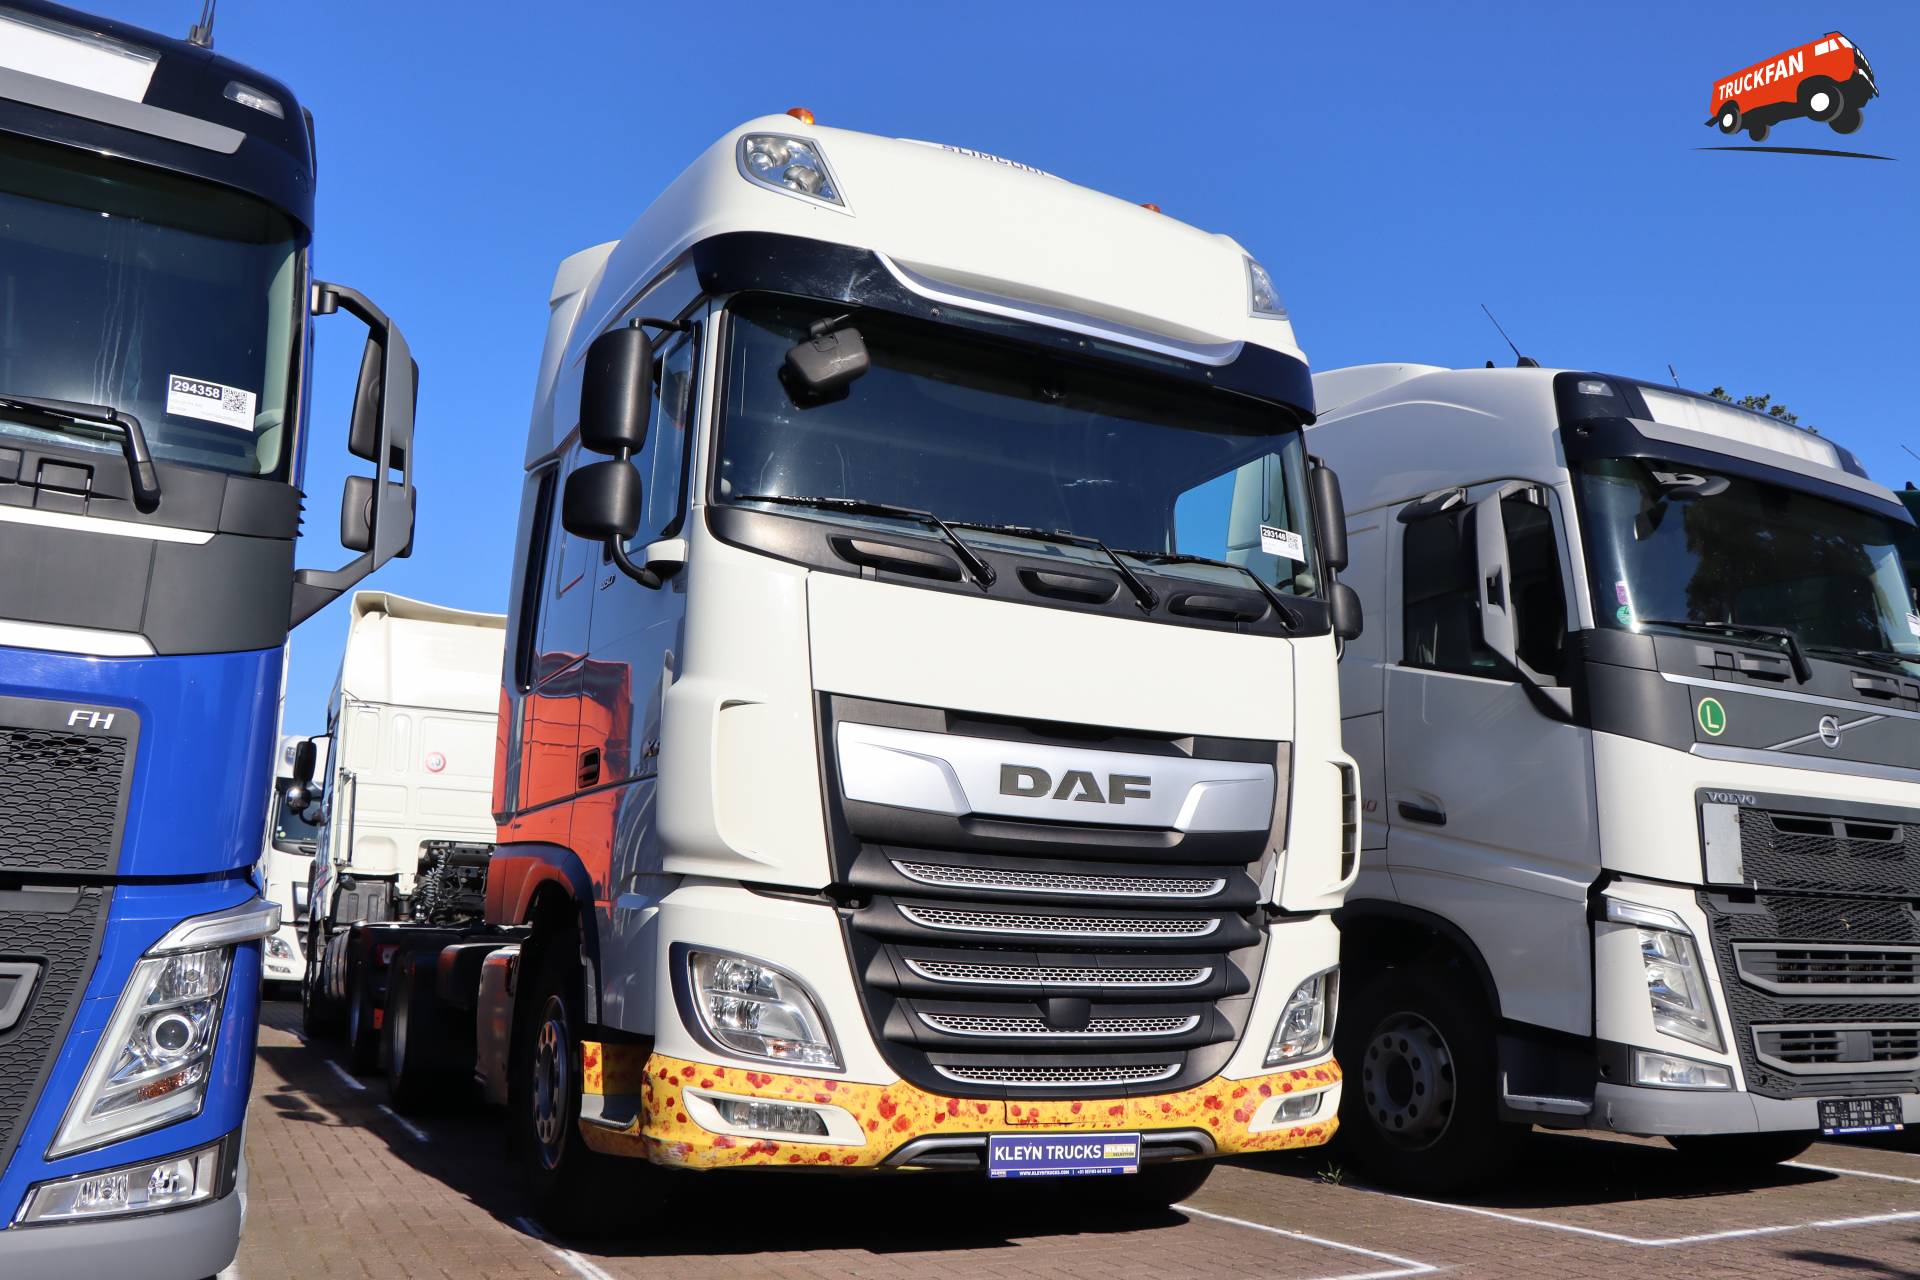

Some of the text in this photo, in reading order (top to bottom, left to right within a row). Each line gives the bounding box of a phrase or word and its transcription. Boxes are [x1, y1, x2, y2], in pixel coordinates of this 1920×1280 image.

[173, 380, 220, 398] 294358
[67, 709, 115, 730] FH
[1706, 704, 1720, 729] L
[999, 763, 1152, 805] DAF
[1705, 791, 1757, 805] VOLVO
[1046, 1145, 1102, 1160] TRUCKS
